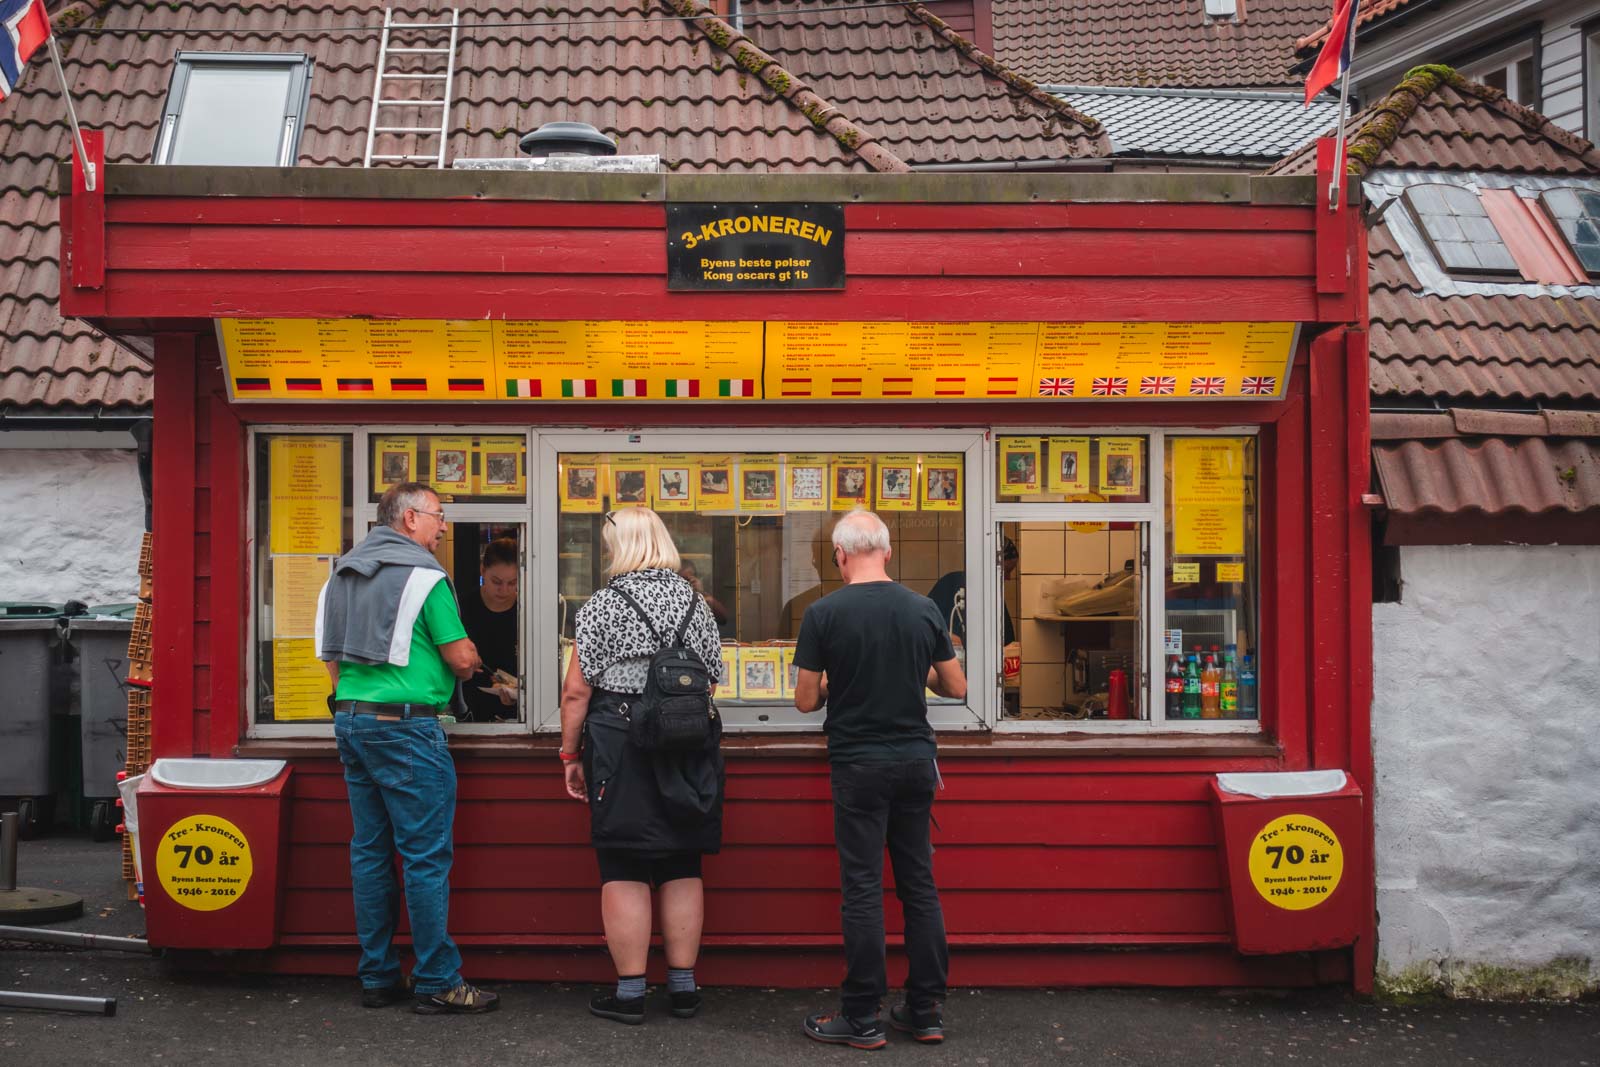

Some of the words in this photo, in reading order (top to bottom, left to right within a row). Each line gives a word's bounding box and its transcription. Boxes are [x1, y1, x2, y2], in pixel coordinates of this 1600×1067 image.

[681, 215, 833, 249] 3-KRONEREN
[700, 258, 736, 270] Byens
[739, 258, 772, 268] beste
[774, 258, 811, 269] pølser
[703, 271, 734, 282] Kong
[736, 272, 776, 280] oscars
[778, 271, 791, 282] gt
[794, 270, 809, 280] 1b
[168, 828, 188, 842] Tre
[195, 823, 245, 849] Kroneren
[1260, 829, 1279, 843] Tre
[1286, 823, 1335, 846] Kroneren
[174, 844, 214, 869] 70
[218, 851, 240, 866] år
[1265, 844, 1305, 869] 70
[1310, 849, 1330, 864] år
[171, 876, 194, 884] Byens
[177, 887, 202, 896] 1946
[210, 887, 236, 896] 2016
[1270, 887, 1295, 896] 1946
[1302, 885, 1328, 894] 2016
